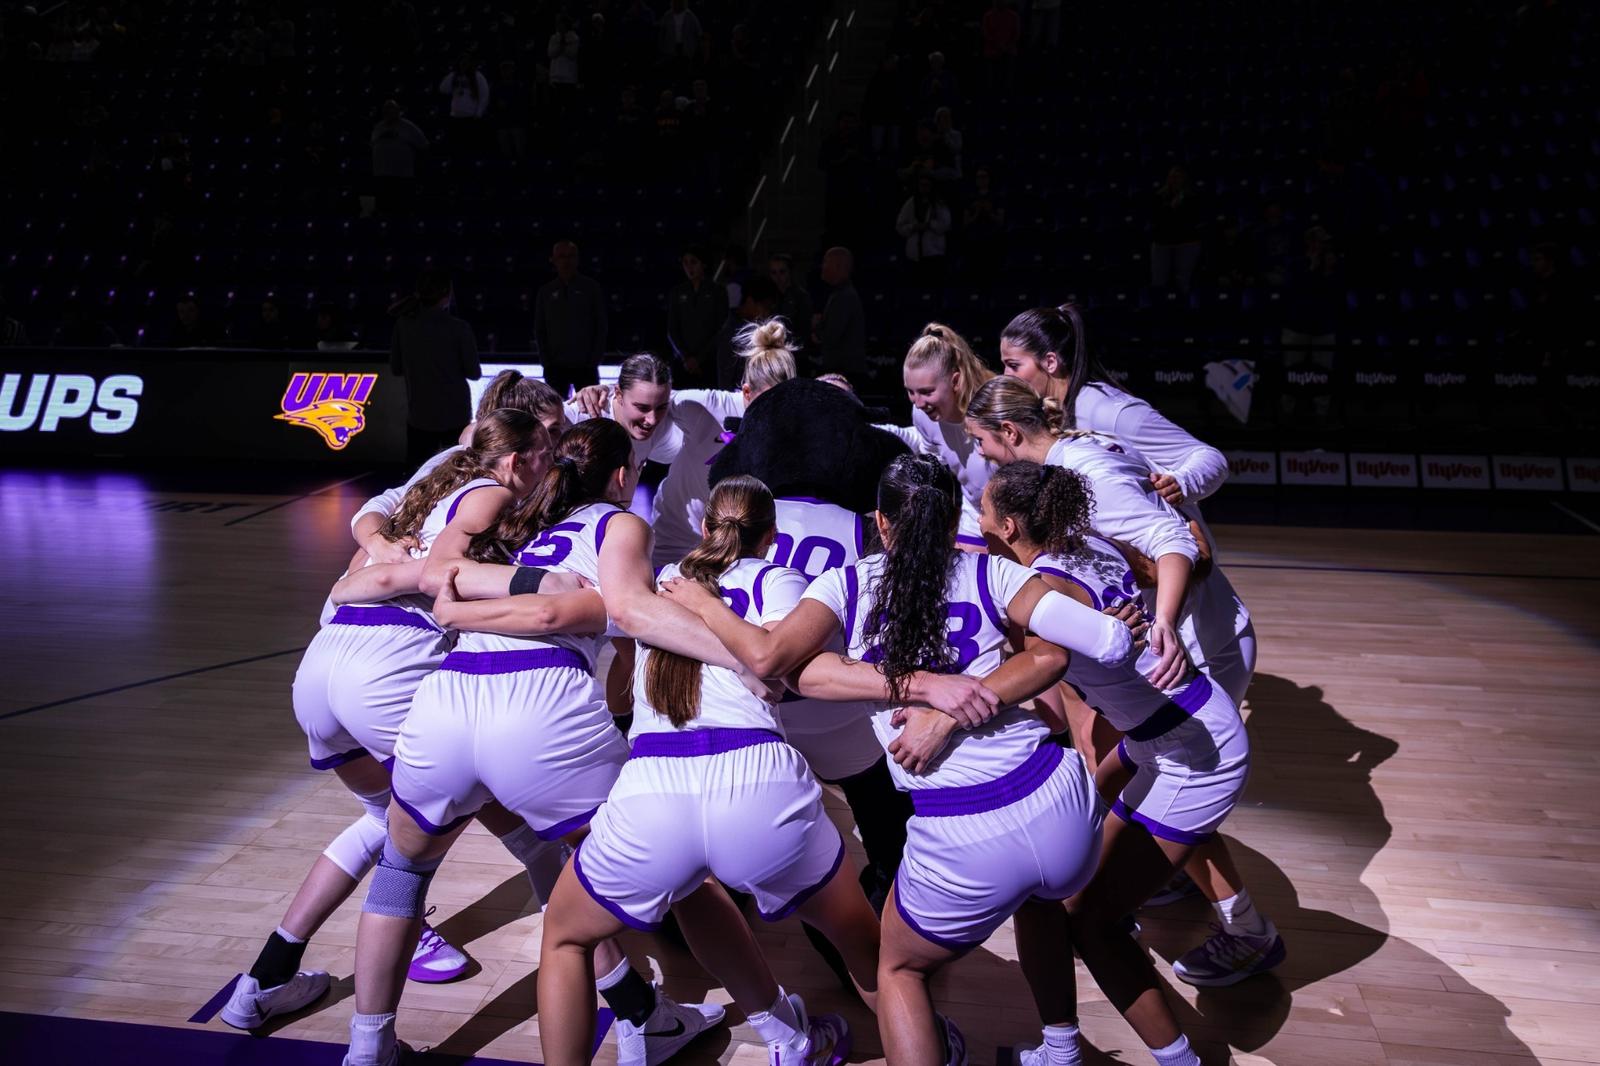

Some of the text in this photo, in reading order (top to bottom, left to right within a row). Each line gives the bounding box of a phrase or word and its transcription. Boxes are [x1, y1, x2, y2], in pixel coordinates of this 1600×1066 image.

[281, 373, 378, 413] UNI
[1229, 458, 1270, 476] yVee
[1286, 458, 1339, 475] HyVee
[1356, 460, 1410, 478] HyVee
[1427, 461, 1482, 480] HyVee
